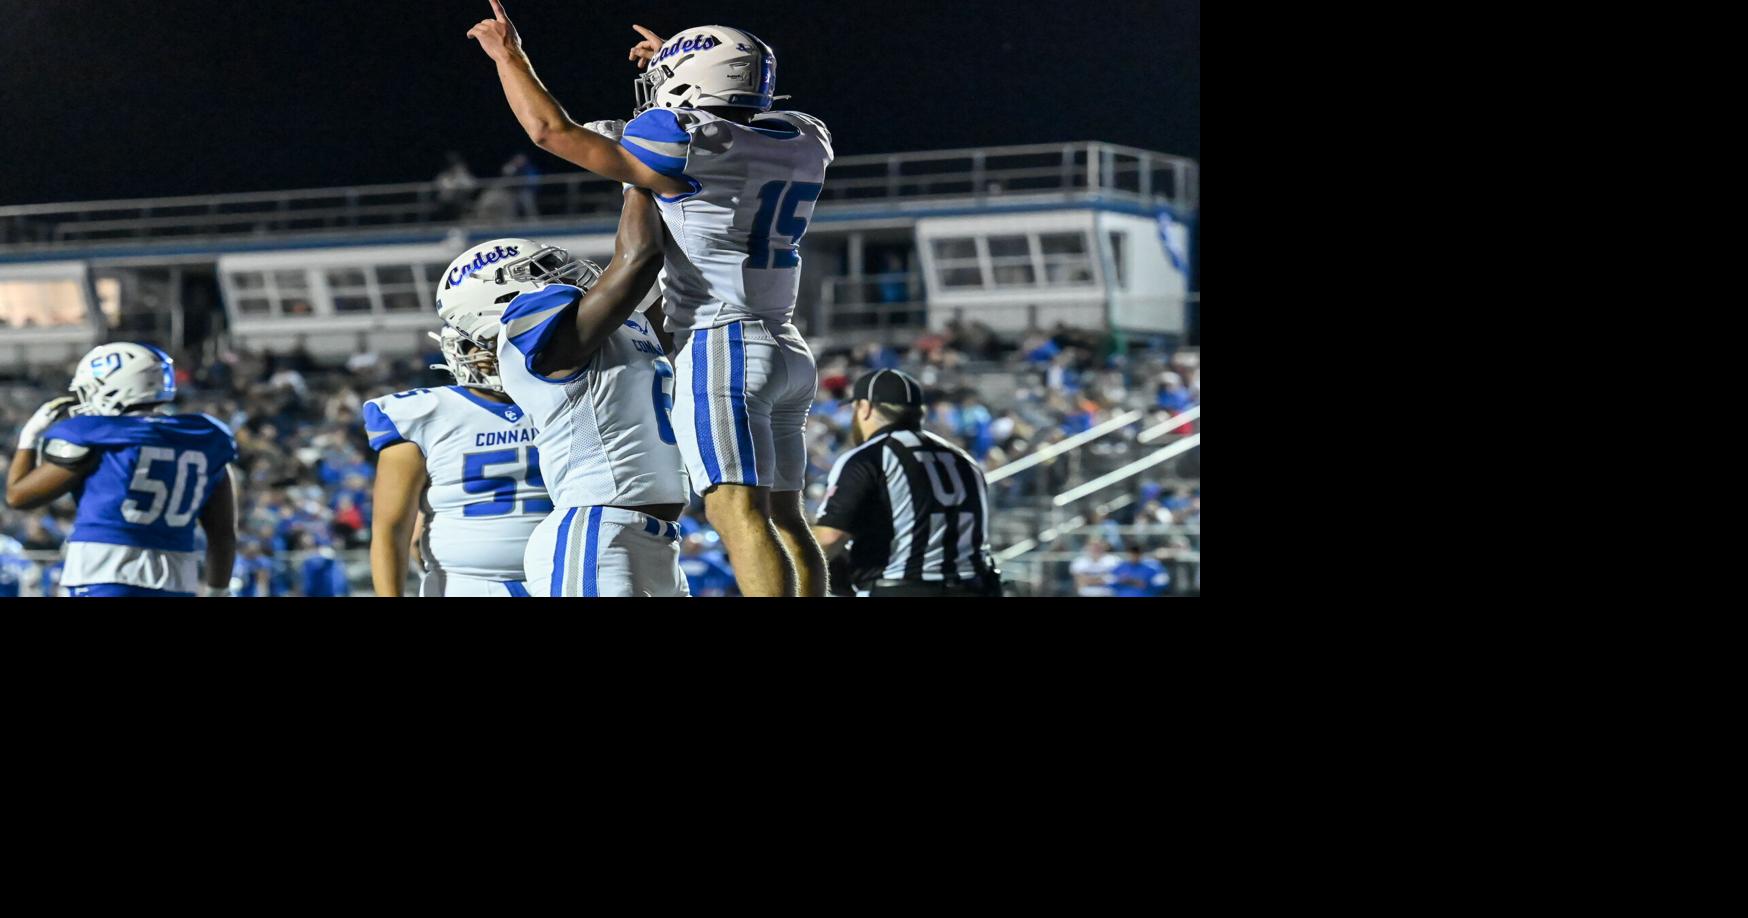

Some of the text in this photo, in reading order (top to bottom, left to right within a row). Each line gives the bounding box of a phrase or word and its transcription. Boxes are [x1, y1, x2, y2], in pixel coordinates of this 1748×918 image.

[742, 179, 823, 269] 15
[449, 245, 519, 286] Cadets
[120, 446, 209, 528] 50
[914, 451, 968, 507] U
